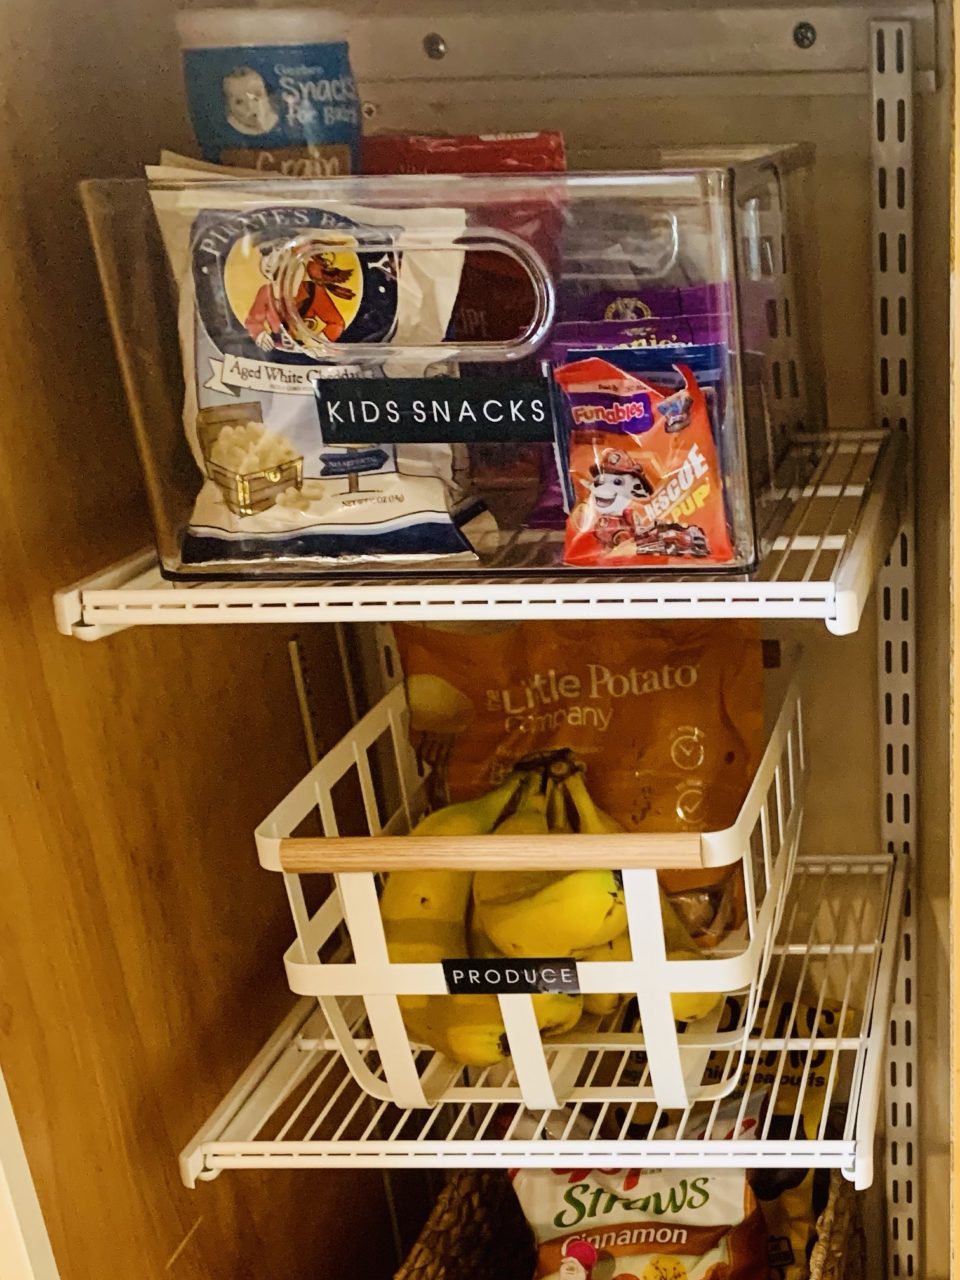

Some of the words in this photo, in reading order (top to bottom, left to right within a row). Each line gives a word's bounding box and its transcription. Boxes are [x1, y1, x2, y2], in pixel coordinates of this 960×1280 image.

[229, 361, 262, 381] Aged
[264, 365, 303, 384] White
[327, 399, 400, 423] KIDS
[412, 399, 545, 423] SNACKS
[572, 400, 644, 425] Funables
[501, 668, 582, 715] Little
[586, 663, 699, 699] Potato
[452, 967, 574, 985] PRODUCE
[553, 1177, 711, 1228] Straws
[561, 1227, 688, 1256] Cinnamon
